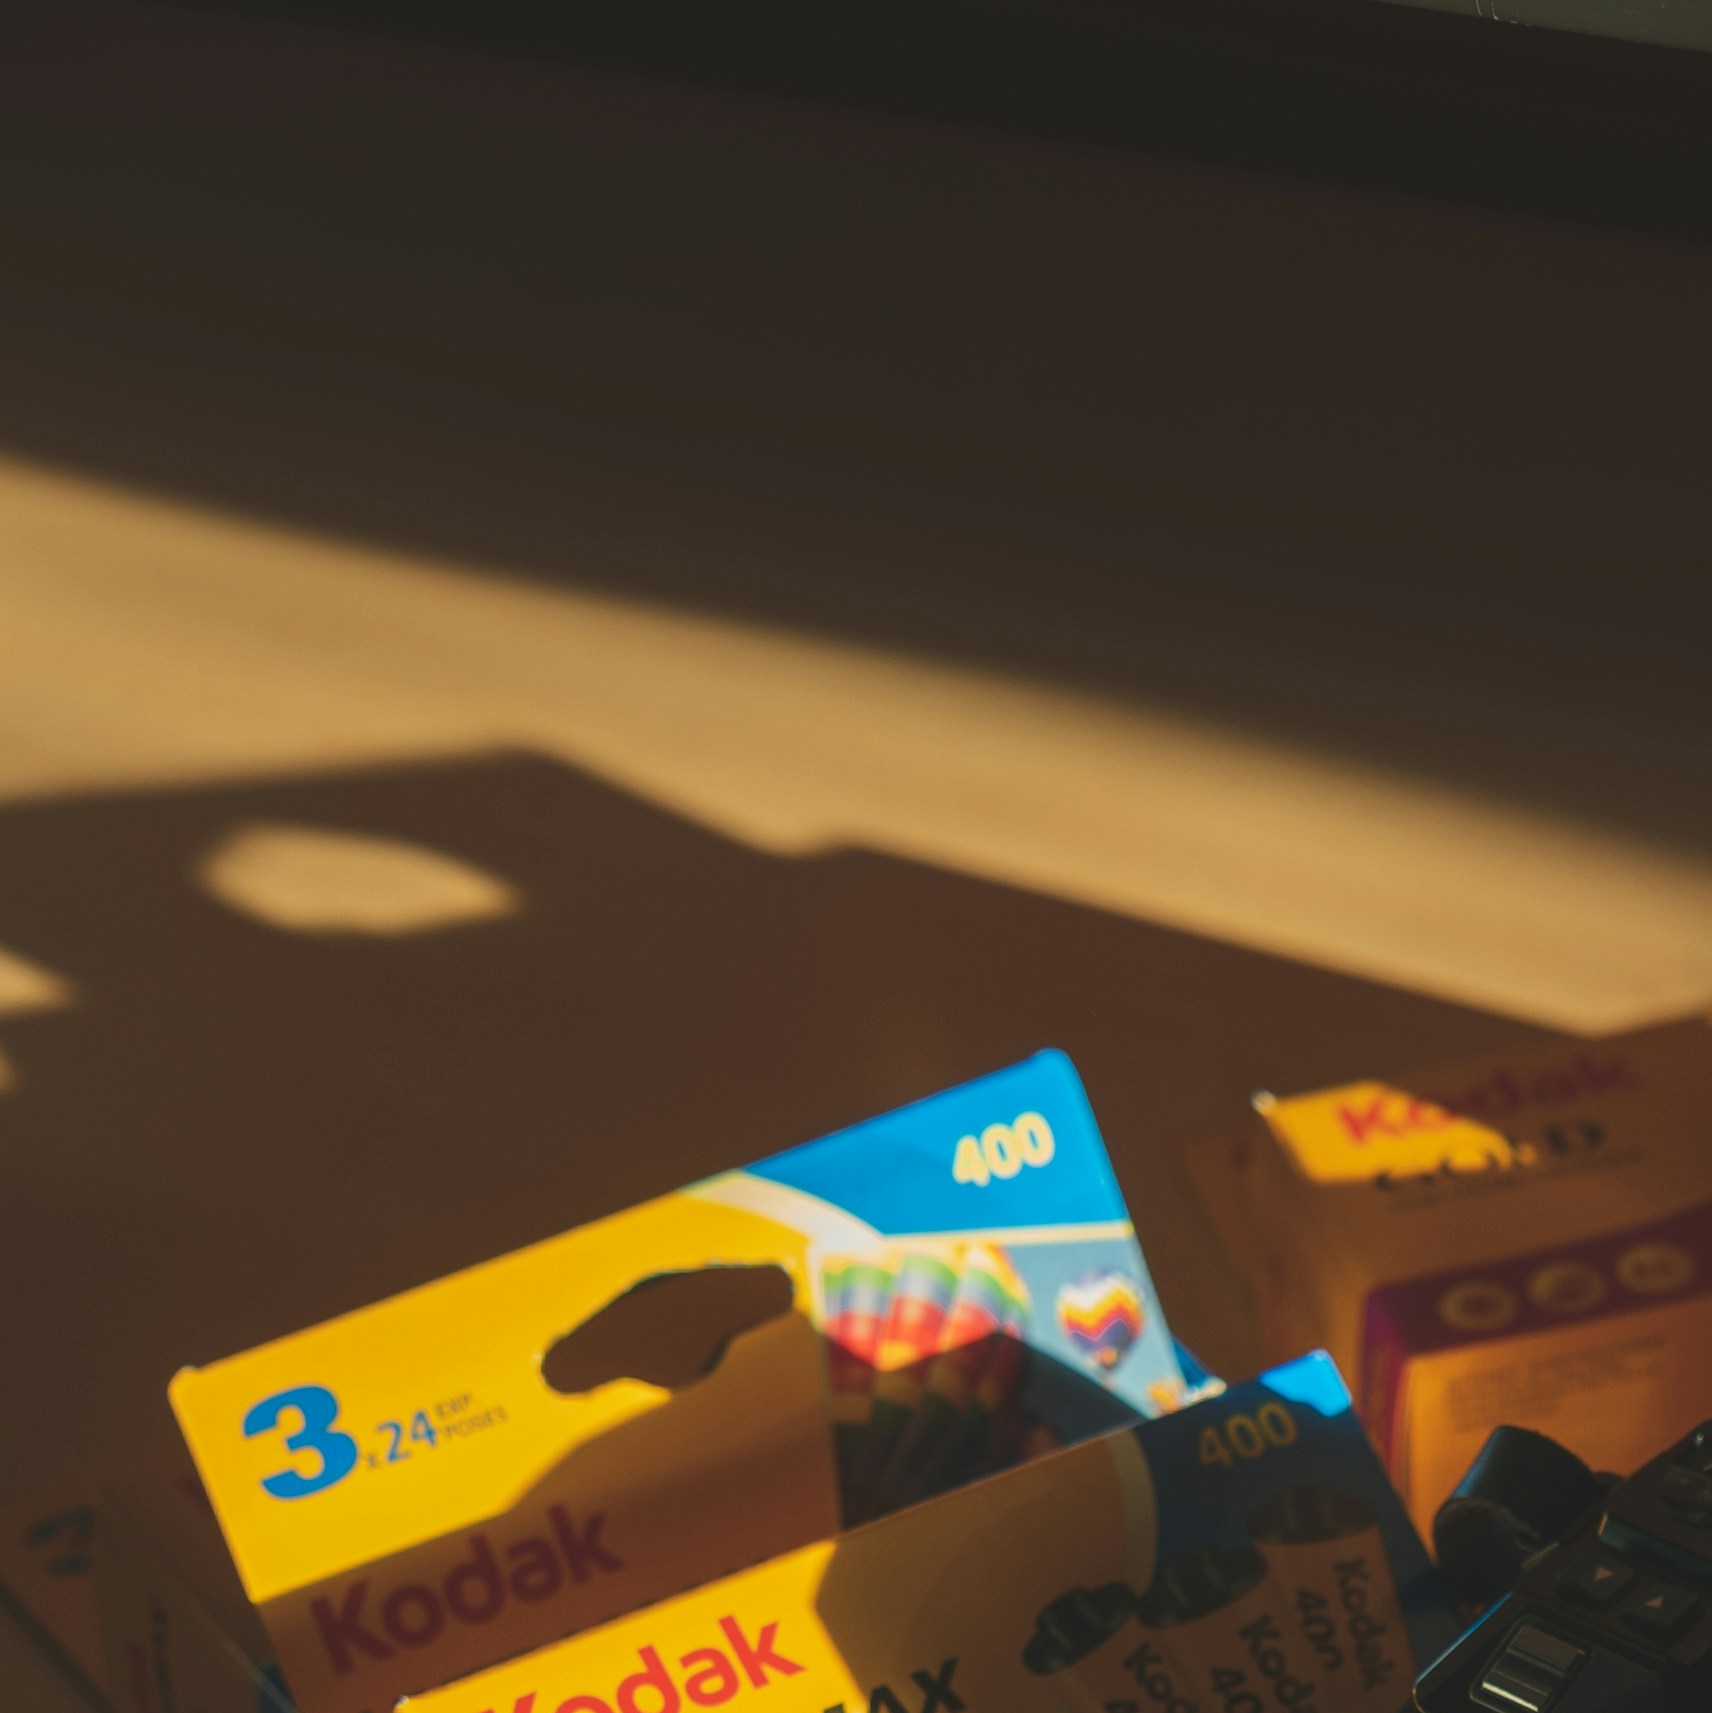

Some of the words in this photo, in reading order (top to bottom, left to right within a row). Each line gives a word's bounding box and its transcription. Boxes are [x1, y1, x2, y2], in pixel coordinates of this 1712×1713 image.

[952, 1111, 1055, 1187] 400
[242, 1382, 358, 1501] 3
[1199, 1402, 1296, 1467] 400
[307, 1503, 625, 1678] Kodak
